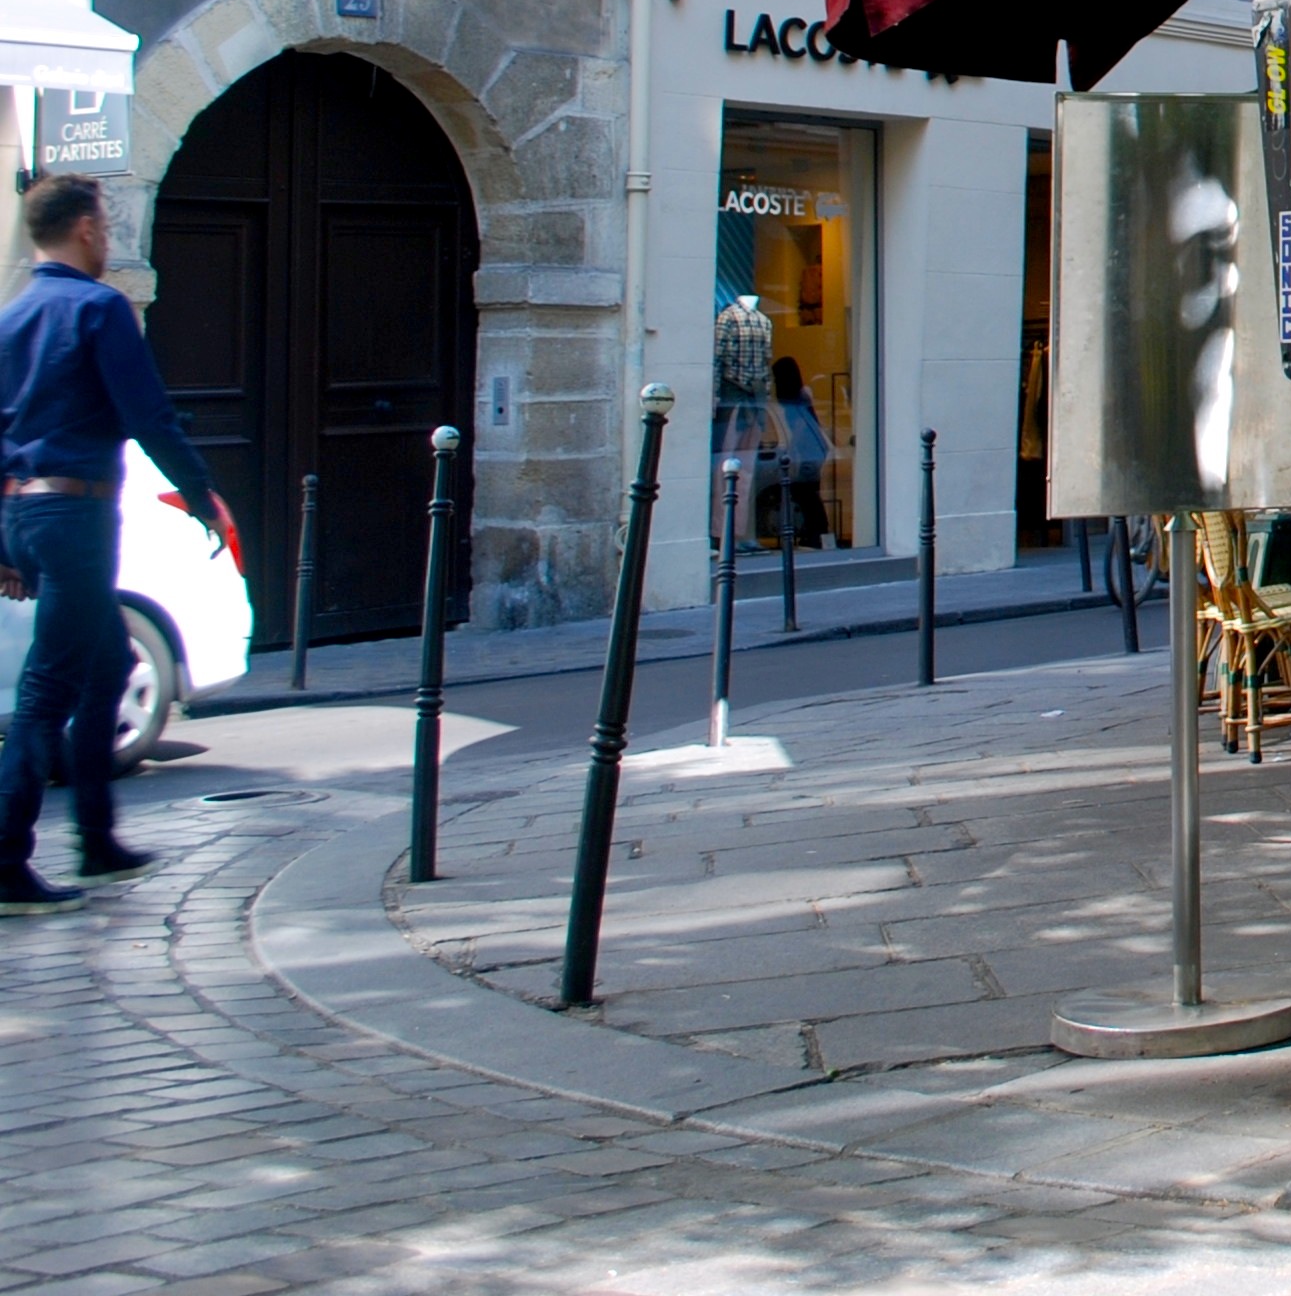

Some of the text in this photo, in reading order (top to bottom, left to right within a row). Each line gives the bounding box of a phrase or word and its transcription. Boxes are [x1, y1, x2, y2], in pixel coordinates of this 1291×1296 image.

[724, 9, 904, 72] LACO
[61, 115, 108, 142] CARRÉ
[45, 139, 123, 164] D'ARTISTES
[718, 190, 805, 217] ACOSTE
